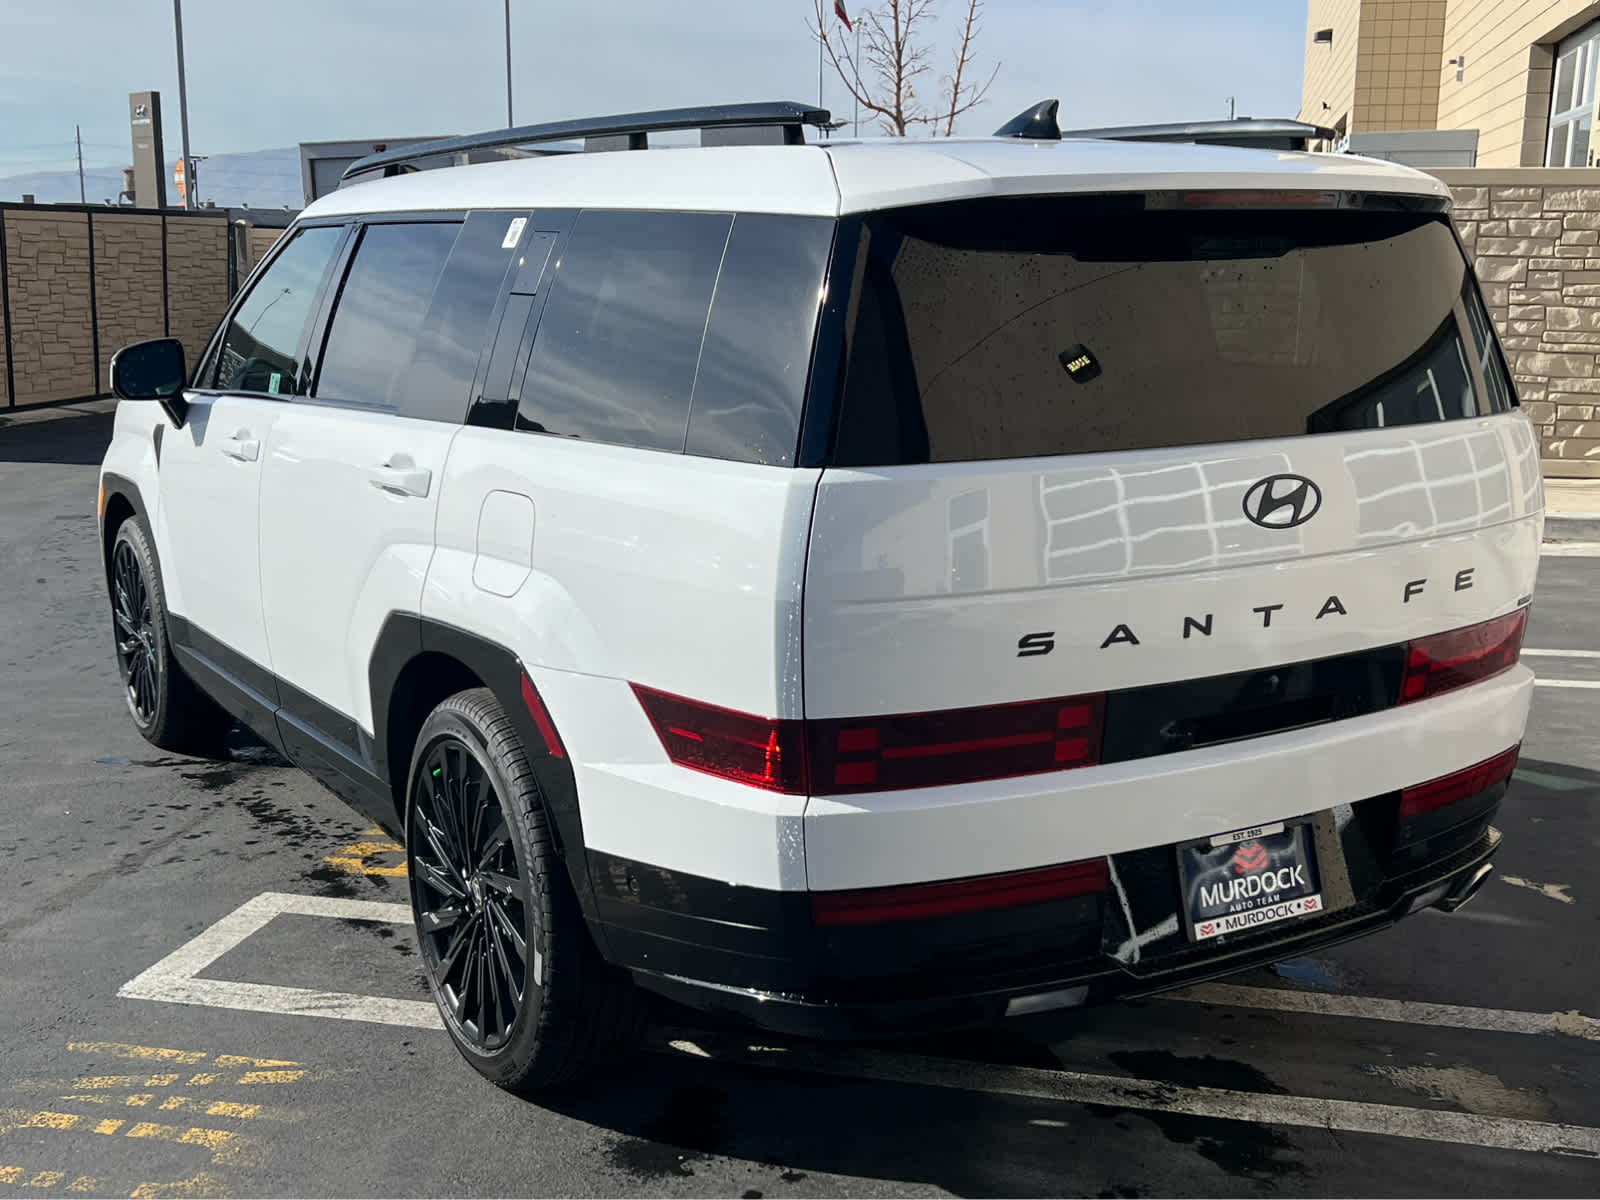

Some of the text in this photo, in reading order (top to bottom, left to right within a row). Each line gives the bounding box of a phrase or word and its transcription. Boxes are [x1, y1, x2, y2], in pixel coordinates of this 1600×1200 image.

[1016, 567, 1475, 658] SANTA FE
[1200, 864, 1305, 908] MURDOCK
[1229, 894, 1281, 913] AUTO TEAM
[1225, 904, 1295, 931] MURDOCK
